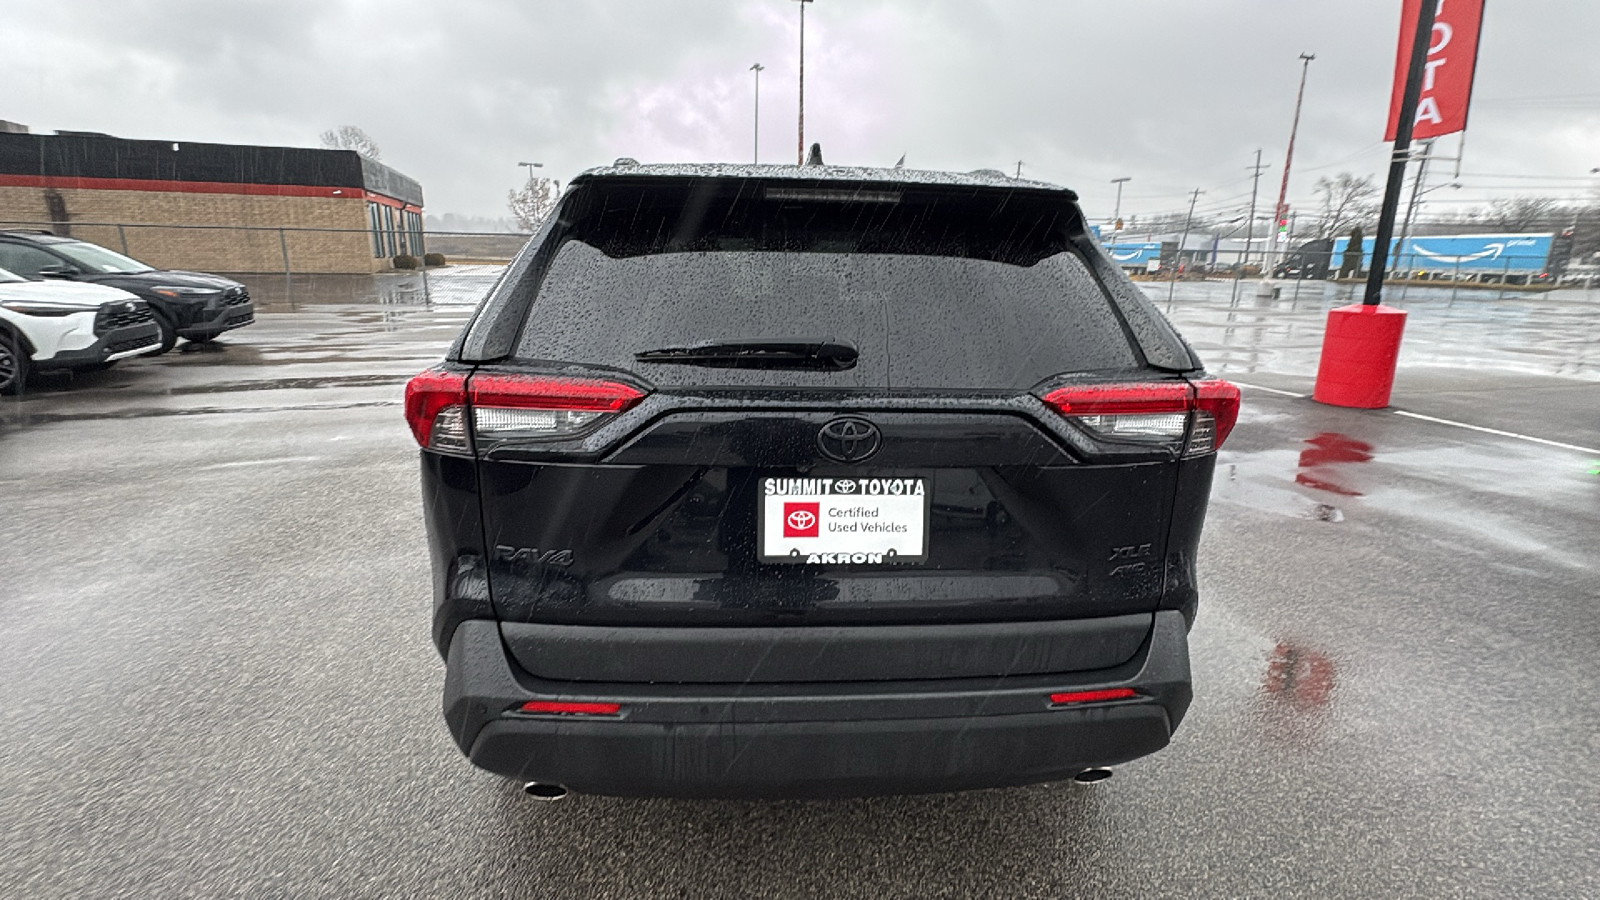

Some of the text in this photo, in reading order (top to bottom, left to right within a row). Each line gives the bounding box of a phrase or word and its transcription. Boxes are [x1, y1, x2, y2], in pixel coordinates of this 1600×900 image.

[1412, 0, 1453, 127] OTA
[764, 477, 925, 496] SUMMIT TOYOTA
[828, 506, 879, 518] Certified
[828, 521, 908, 533] Used Vehicles
[806, 552, 883, 564] AKRON
